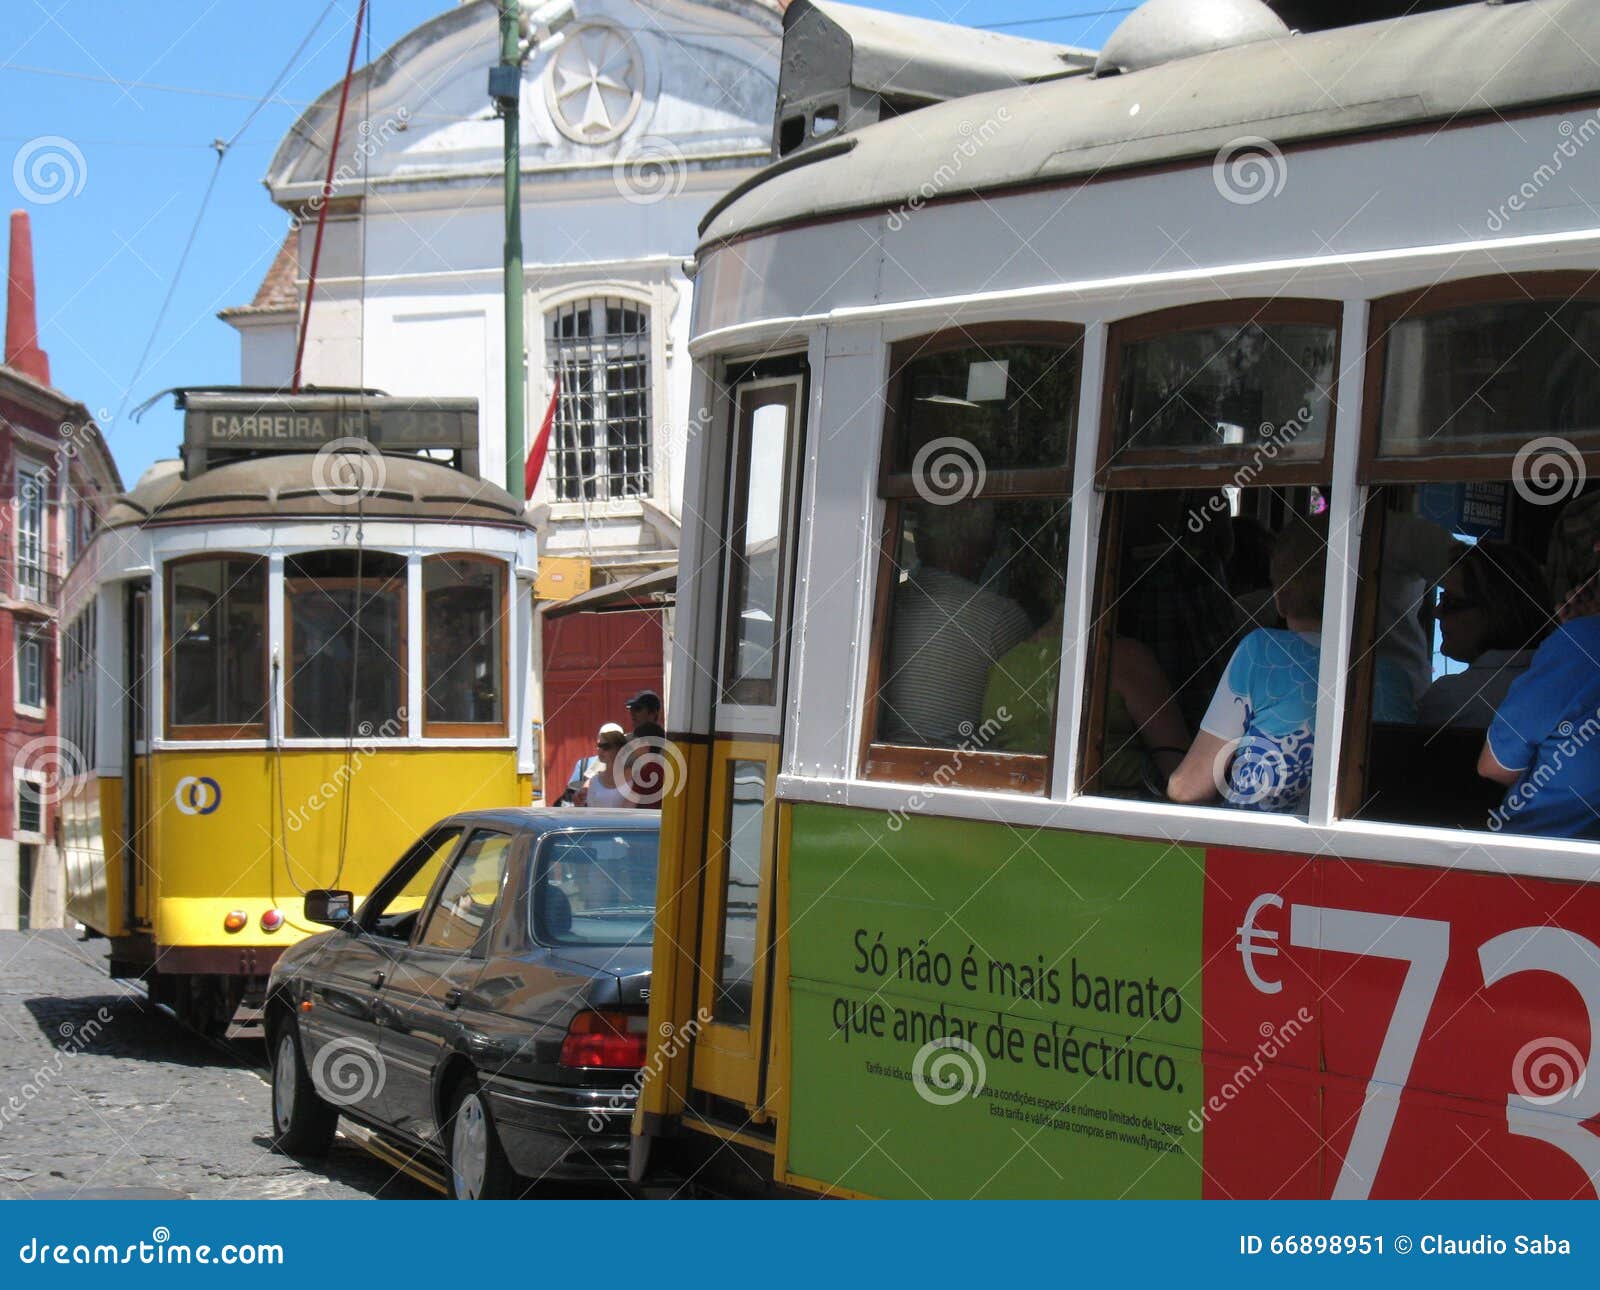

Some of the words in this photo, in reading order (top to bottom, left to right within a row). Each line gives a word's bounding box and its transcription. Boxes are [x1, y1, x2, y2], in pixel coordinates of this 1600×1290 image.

[212, 415, 327, 438] CARREIRA
[854, 929, 889, 977] Só
[896, 938, 952, 987] não
[960, 944, 979, 992] é
[988, 954, 1061, 1006] mais
[1071, 957, 1183, 1025] barato
[832, 996, 886, 1044] que
[892, 1002, 979, 1054] andar
[985, 1011, 1026, 1065] de
[1033, 1020, 1185, 1094] eléctrico.
[990, 1103, 1005, 1118] Esta
[1053, 1119, 1071, 1132] para
[1072, 1122, 1105, 1139] compras
[1106, 1130, 1118, 1140] em
[1078, 1104, 1108, 1121] número
[1109, 1109, 1140, 1128] limitado
[1142, 1116, 1153, 1130] de
